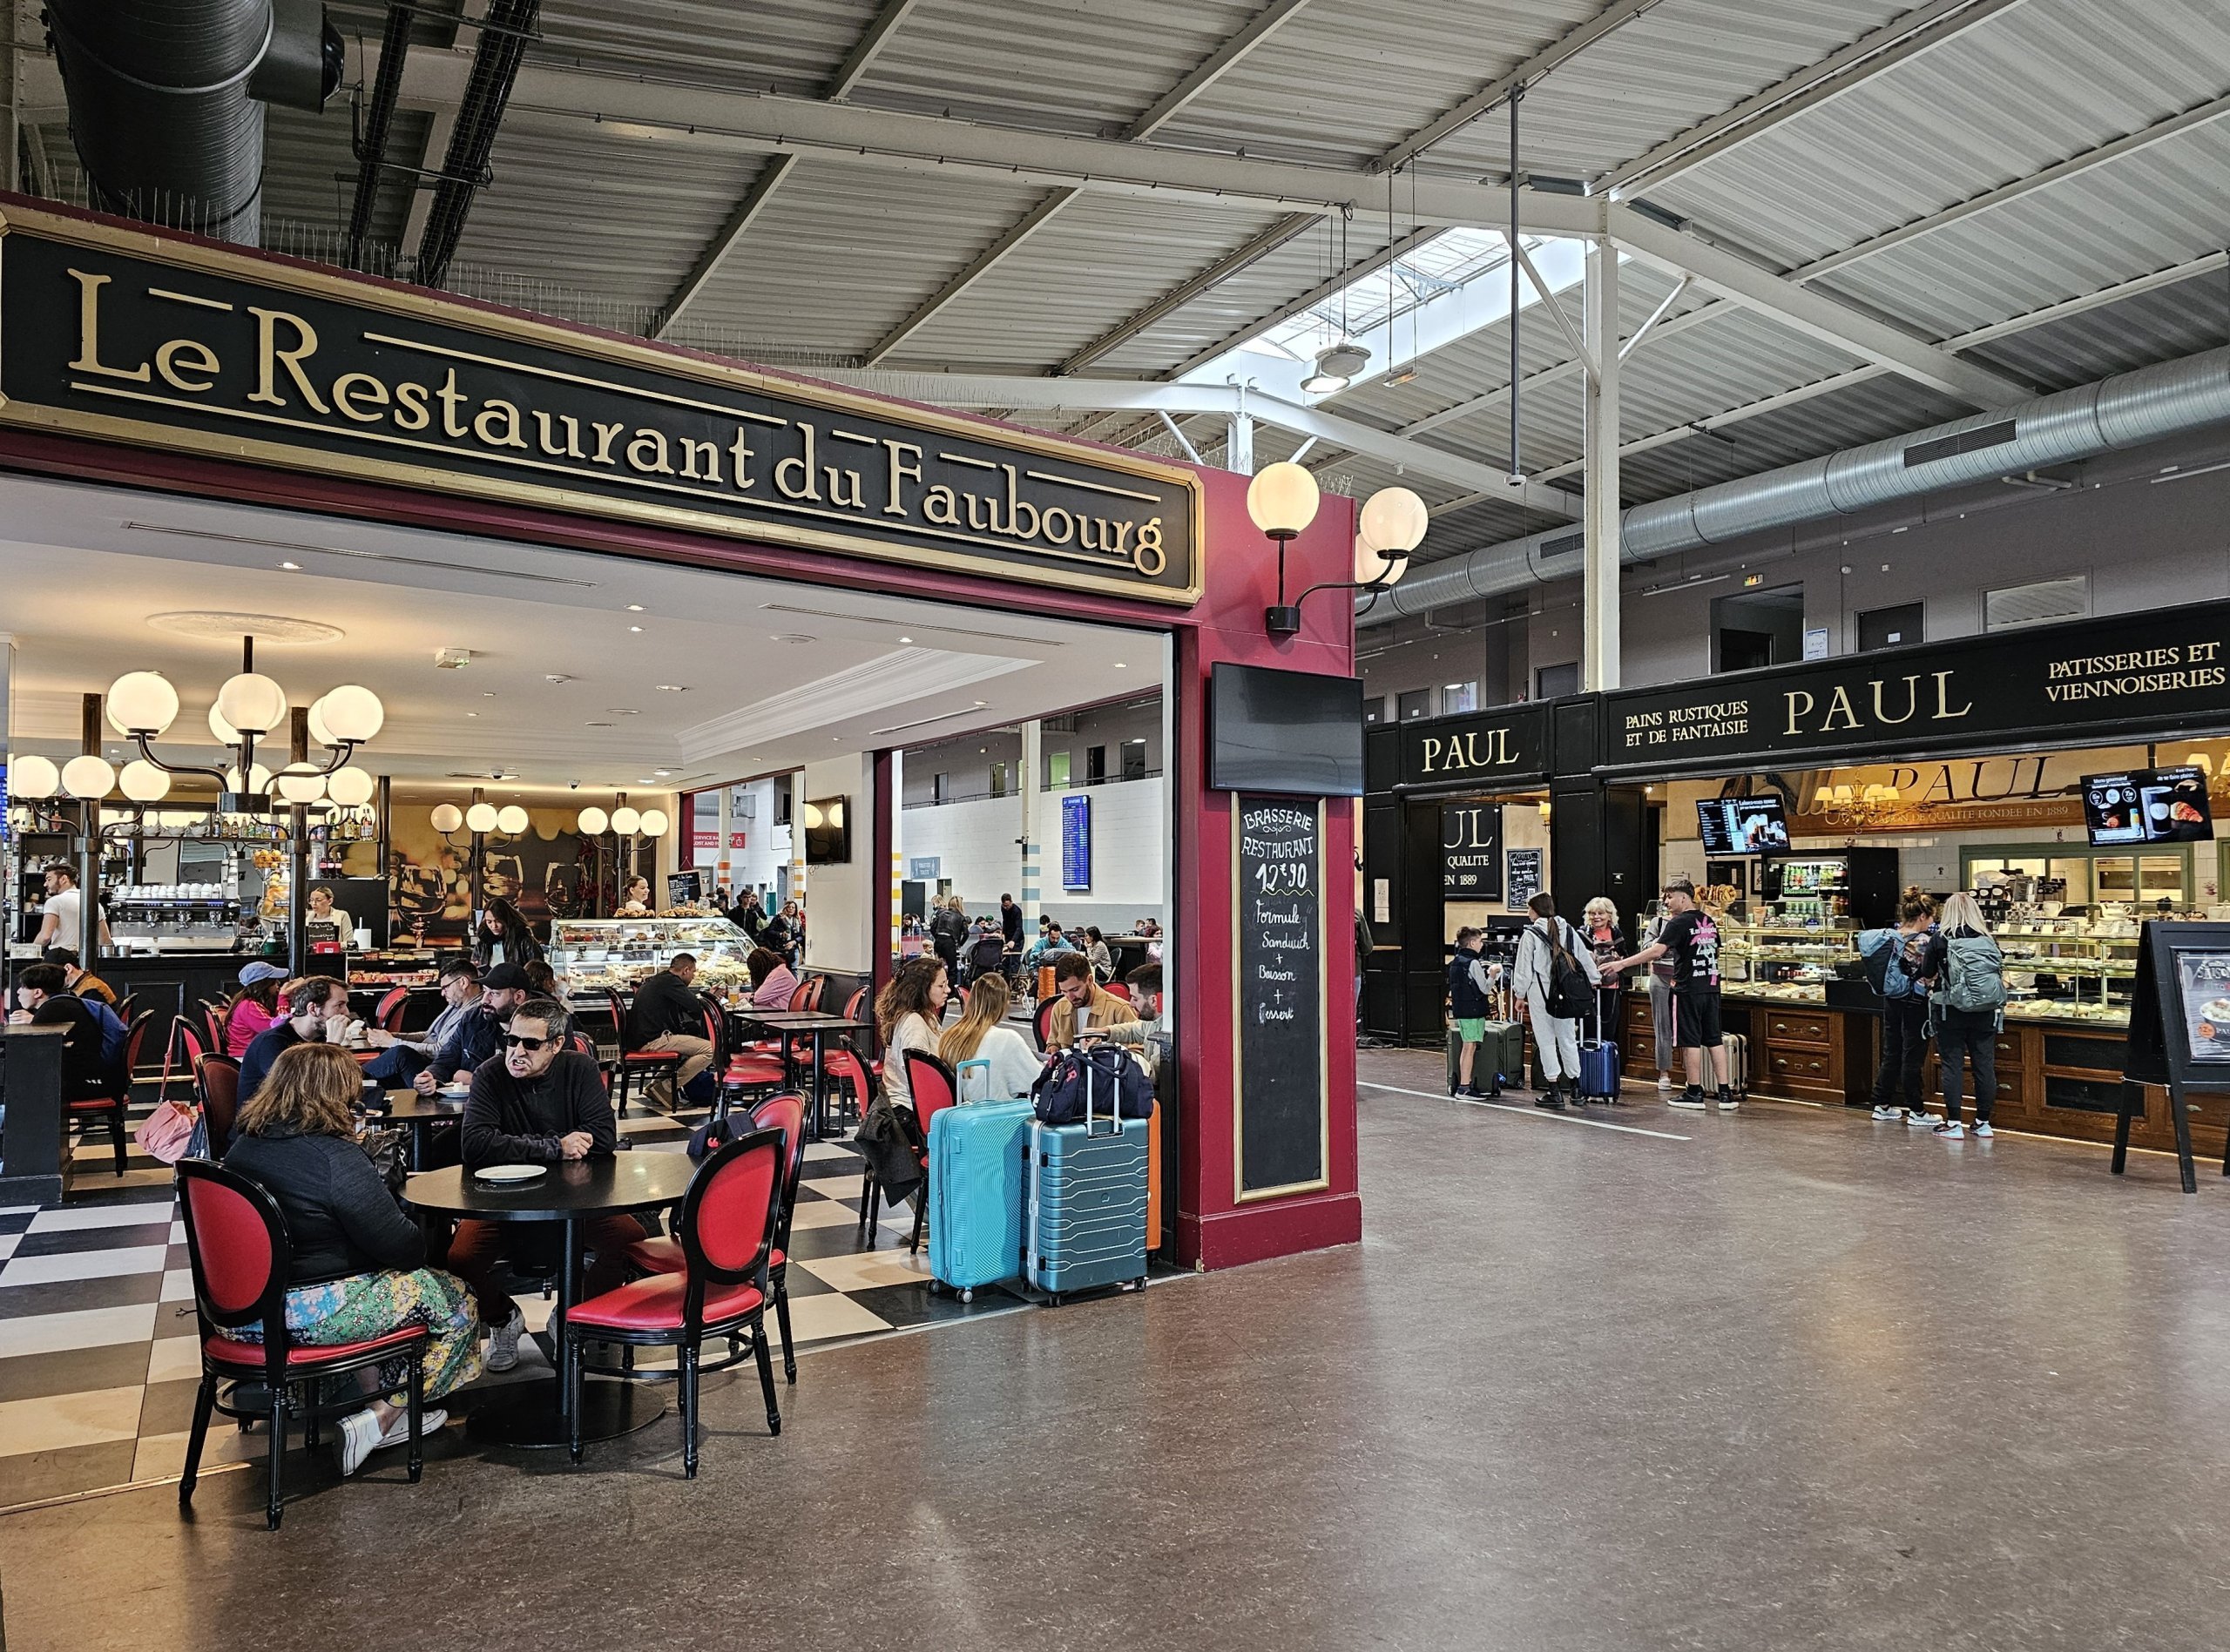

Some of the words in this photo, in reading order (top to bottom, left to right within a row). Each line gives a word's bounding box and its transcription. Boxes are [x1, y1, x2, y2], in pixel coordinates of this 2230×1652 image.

[66, 267, 221, 392] Le
[247, 306, 756, 489] Restaurant
[774, 420, 867, 509] du
[882, 436, 1167, 577] Faubourg
[2049, 646, 2179, 679] PATISSERIES
[2187, 641, 2220, 663] ET
[2045, 667, 2227, 702] VIENNOISERIES
[1625, 711, 1662, 730] PAINS
[1669, 700, 1748, 724] RUSTIQUES
[1783, 670, 1973, 735] PAUL
[1625, 732, 1642, 747] ET
[1649, 730, 1667, 745] DE
[1672, 718, 1748, 743] FANTAISIE
[1422, 728, 1519, 772] PAUL
[1889, 756, 2063, 802] PAUL
[1243, 808, 1313, 831] BRASSERIE
[1443, 809, 1492, 848] UL
[1912, 813, 1925, 822] DE
[1929, 810, 1975, 823] QUALITE
[1978, 808, 2023, 819] FONDEE
[2026, 806, 2043, 817] EN
[2047, 806, 2069, 816] 1889
[1240, 836, 1314, 859] RESTAURANT
[1447, 855, 1490, 869] QUALITE
[1459, 873, 1477, 886] 1889
[1256, 899, 1301, 924] Formule
[1262, 930, 1311, 950] Sandwich
[1259, 964, 1296, 981] Boisson
